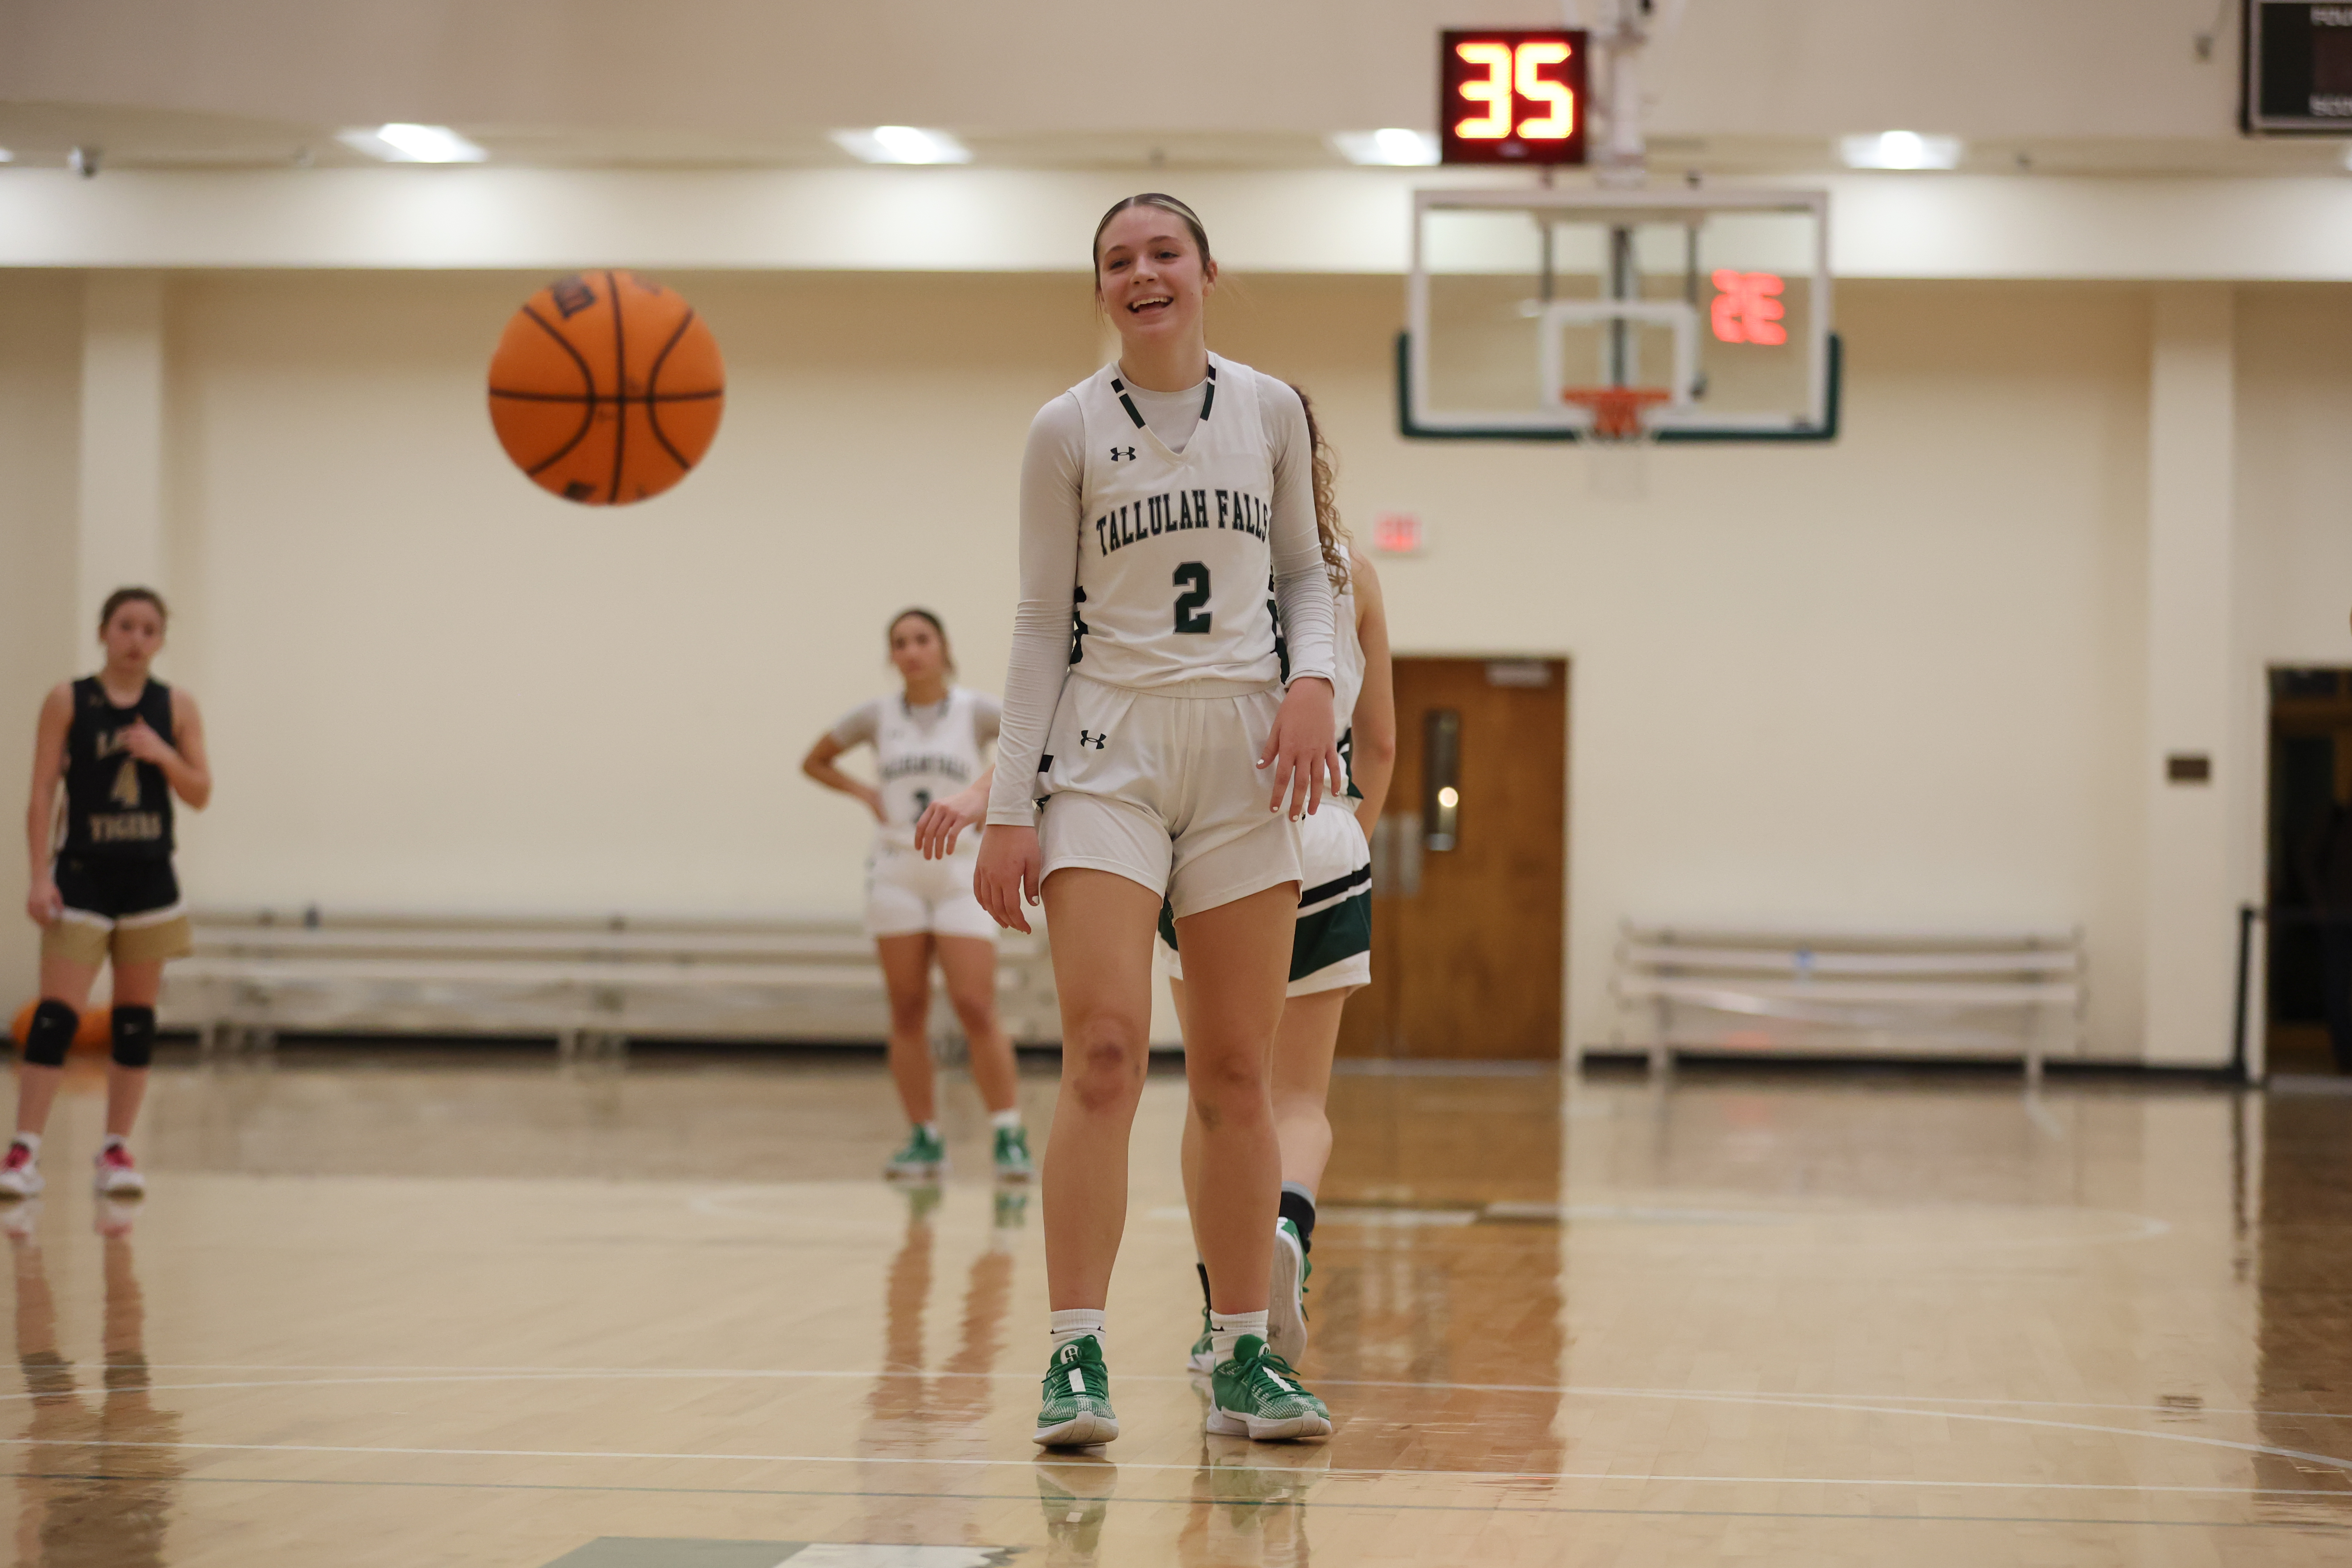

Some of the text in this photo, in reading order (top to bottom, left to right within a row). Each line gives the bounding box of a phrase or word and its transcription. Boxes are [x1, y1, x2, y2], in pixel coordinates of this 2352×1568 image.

[1456, 43, 1573, 139] 35
[1096, 489, 1209, 557] TALLULAH
[1172, 561, 1212, 635] 2
[110, 760, 141, 807] 4
